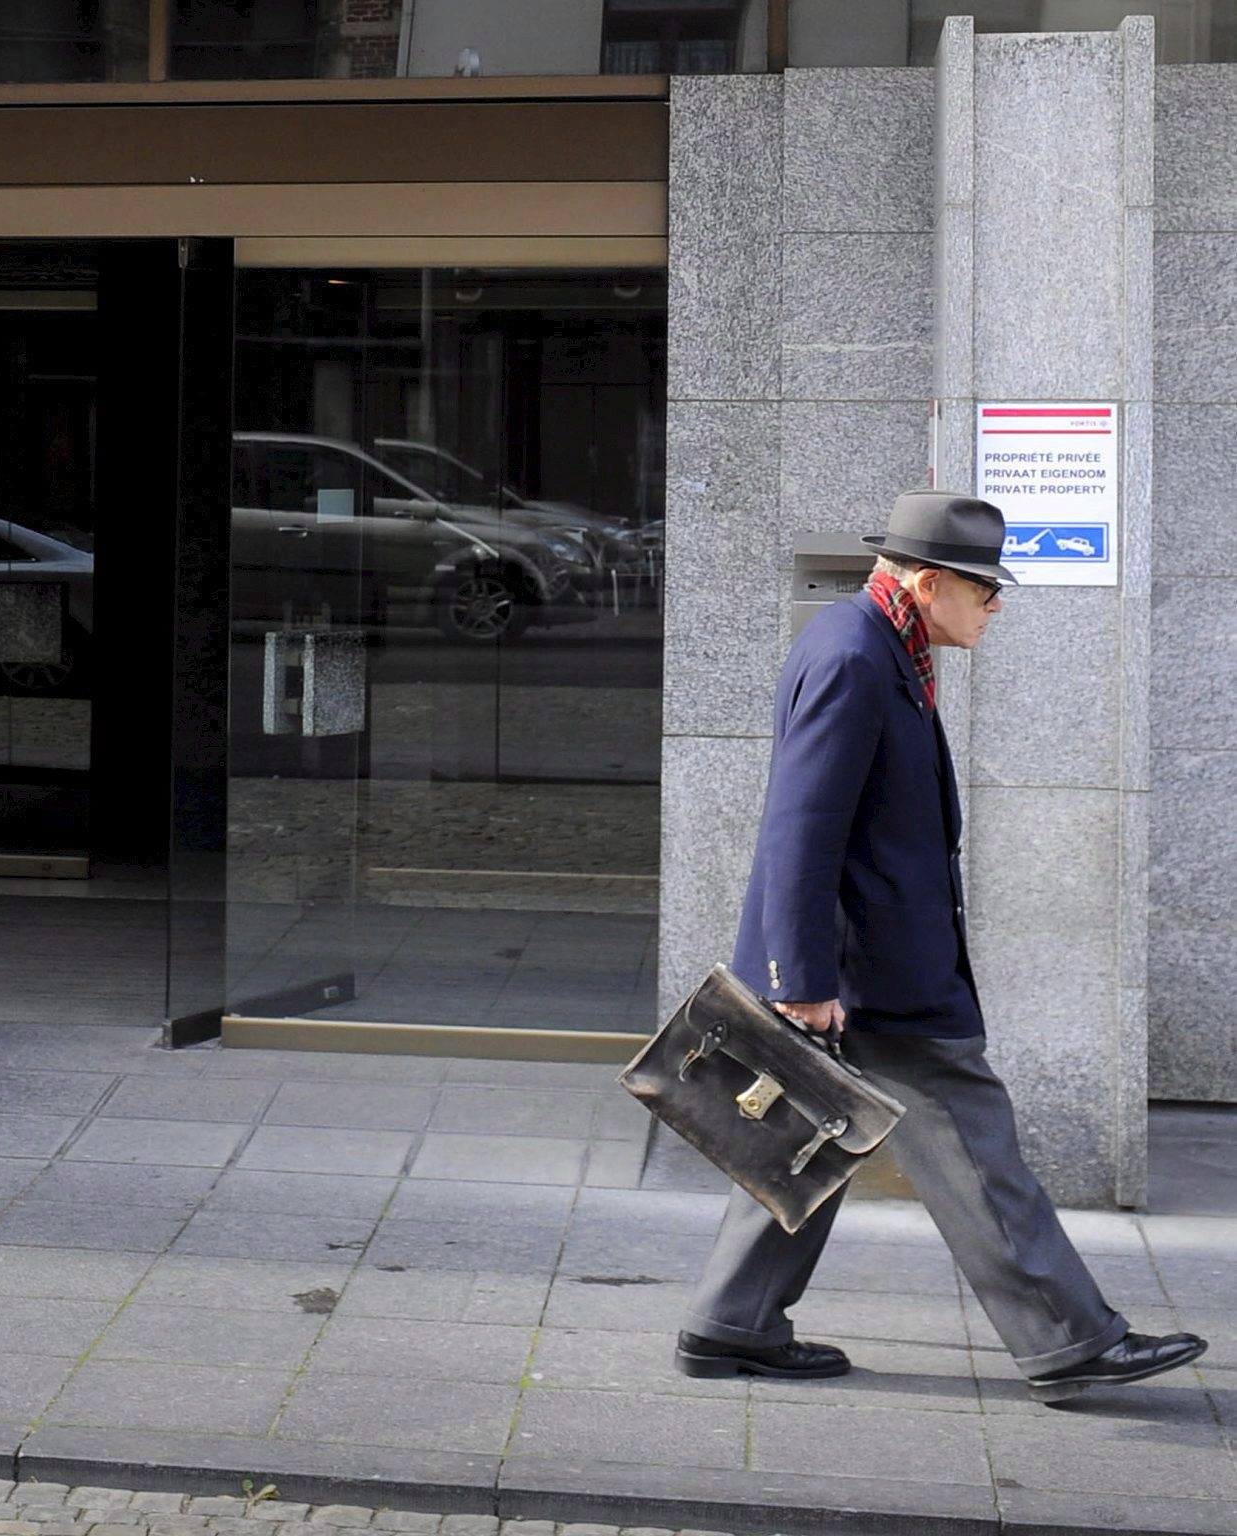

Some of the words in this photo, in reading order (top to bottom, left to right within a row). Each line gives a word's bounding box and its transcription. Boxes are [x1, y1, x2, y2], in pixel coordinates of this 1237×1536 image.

[984, 452, 1053, 463] PROPRIÉTÉ
[1057, 452, 1101, 463] PRIVÉE
[984, 468, 1037, 479] PRIVAAT
[1040, 468, 1106, 479] EIGENDOM
[984, 484, 1036, 495] PRIVATE
[1039, 484, 1106, 495] PROPERTY
